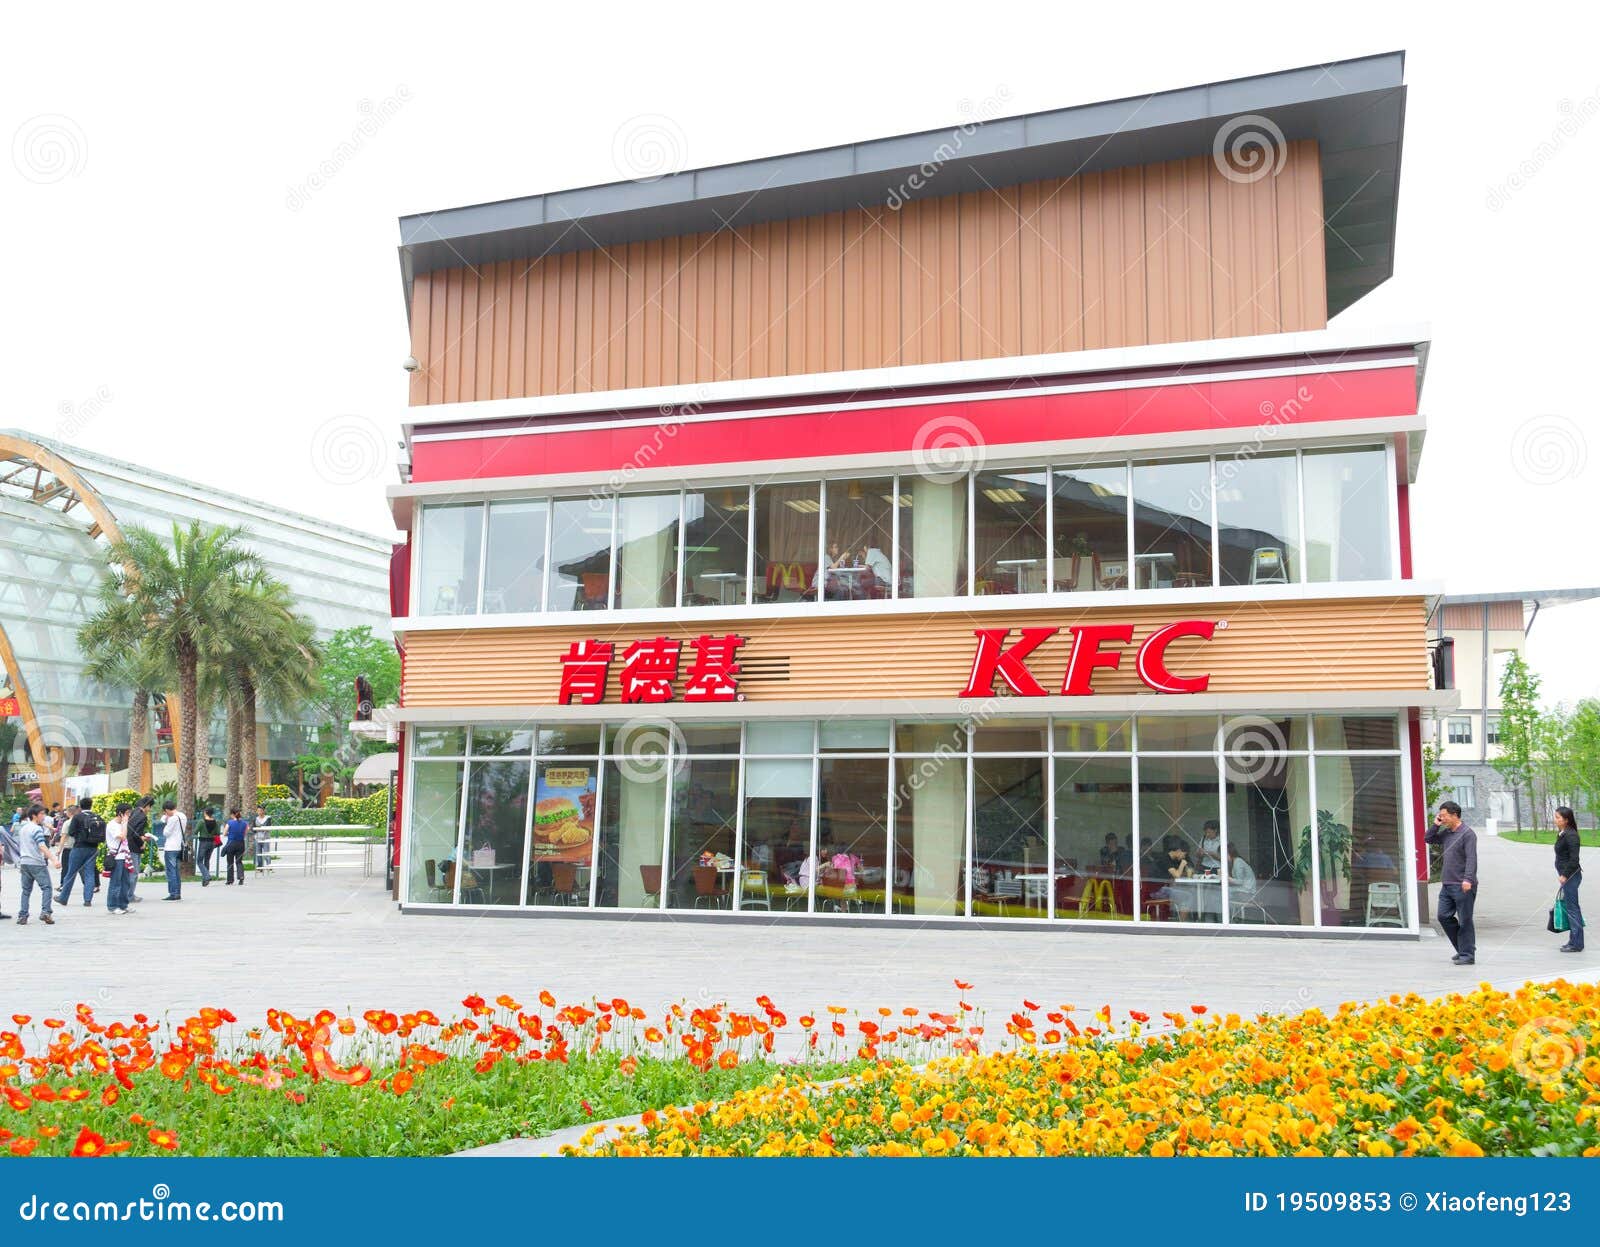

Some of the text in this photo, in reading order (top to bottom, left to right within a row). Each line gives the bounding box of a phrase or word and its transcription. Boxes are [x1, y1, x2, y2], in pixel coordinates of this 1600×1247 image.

[558, 634, 745, 705] 肯德基
[958, 620, 1217, 697] KFC
